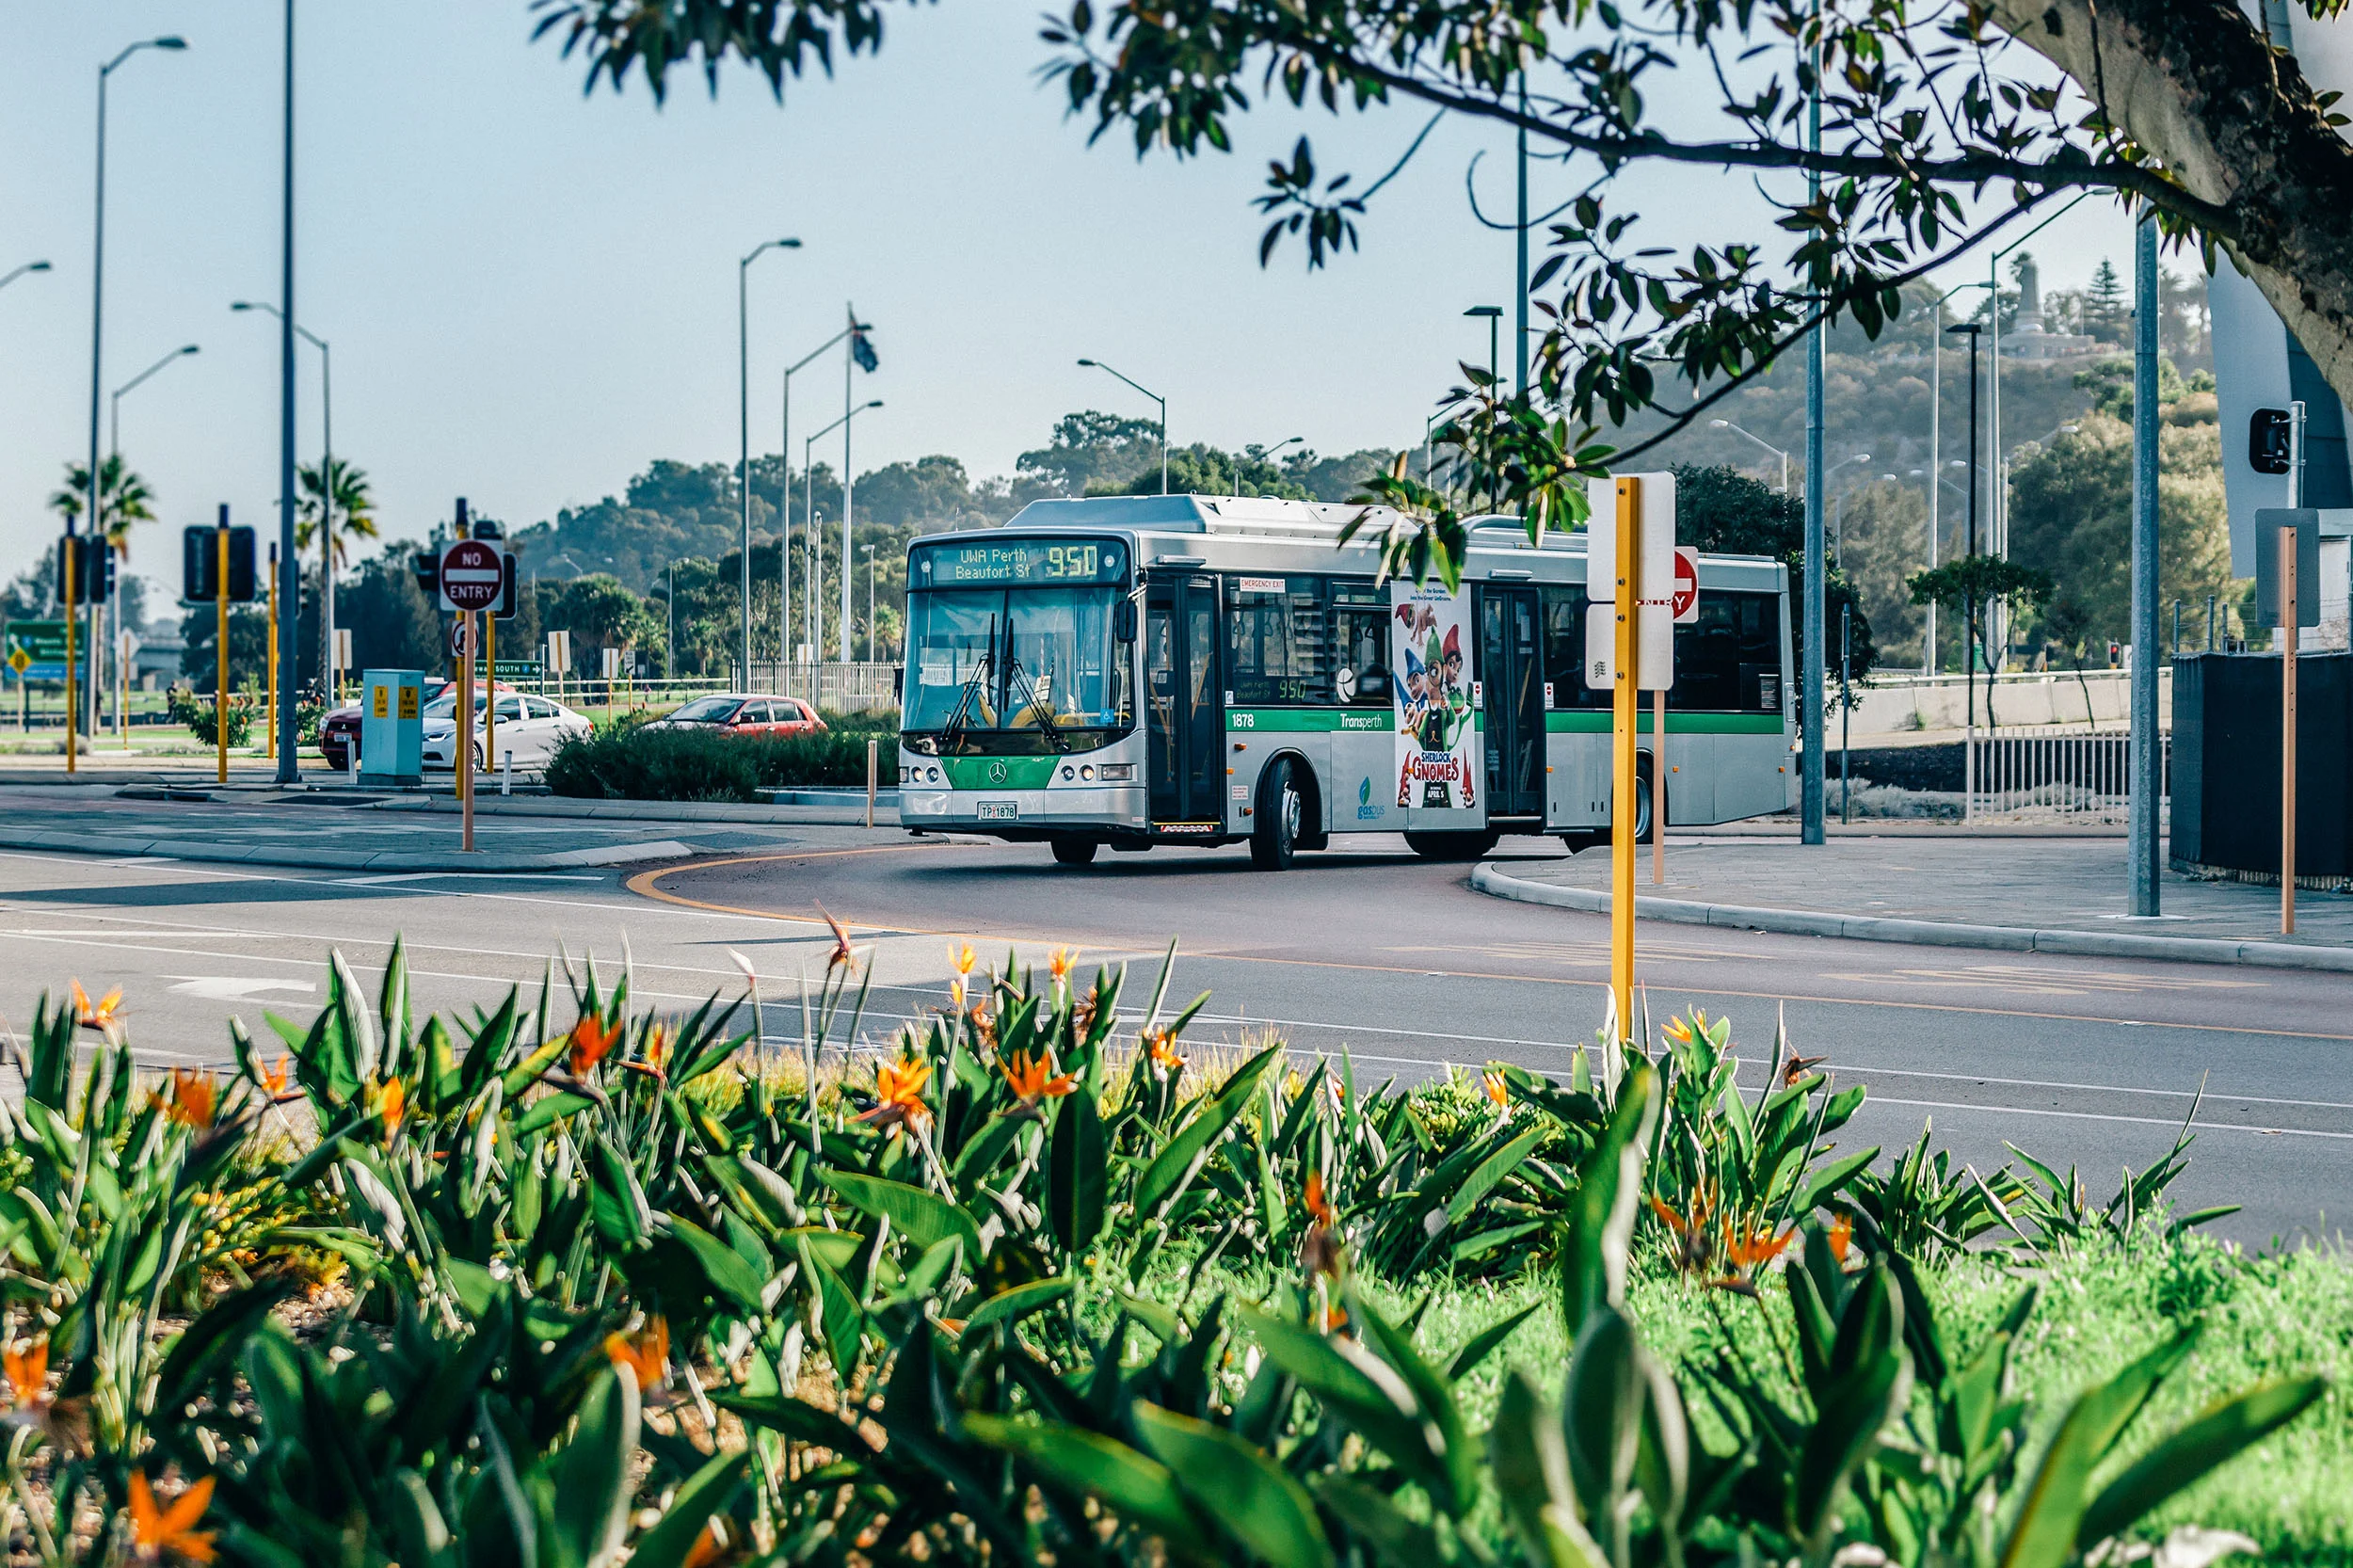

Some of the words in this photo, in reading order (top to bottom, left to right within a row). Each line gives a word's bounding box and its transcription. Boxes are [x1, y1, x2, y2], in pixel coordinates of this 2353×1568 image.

[462, 552, 481, 566] NO
[960, 550, 987, 563] UWA
[991, 548, 1027, 563] Perth
[1048, 545, 1097, 577] 950
[955, 565, 1010, 580] Beaufort
[1016, 564, 1031, 578] St
[1241, 579, 1272, 588] EMERGENCY
[450, 585, 493, 600] ENTRY
[495, 664, 520, 673] SOUTH
[1279, 680, 1306, 698] 950
[1232, 713, 1255, 728] 1878
[1339, 712, 1383, 730] Transperth
[1421, 752, 1451, 763] SHERLOCK
[1413, 756, 1459, 781] GNOMES
[1427, 790, 1440, 798] APRIL
[1440, 790, 1445, 798] 5
